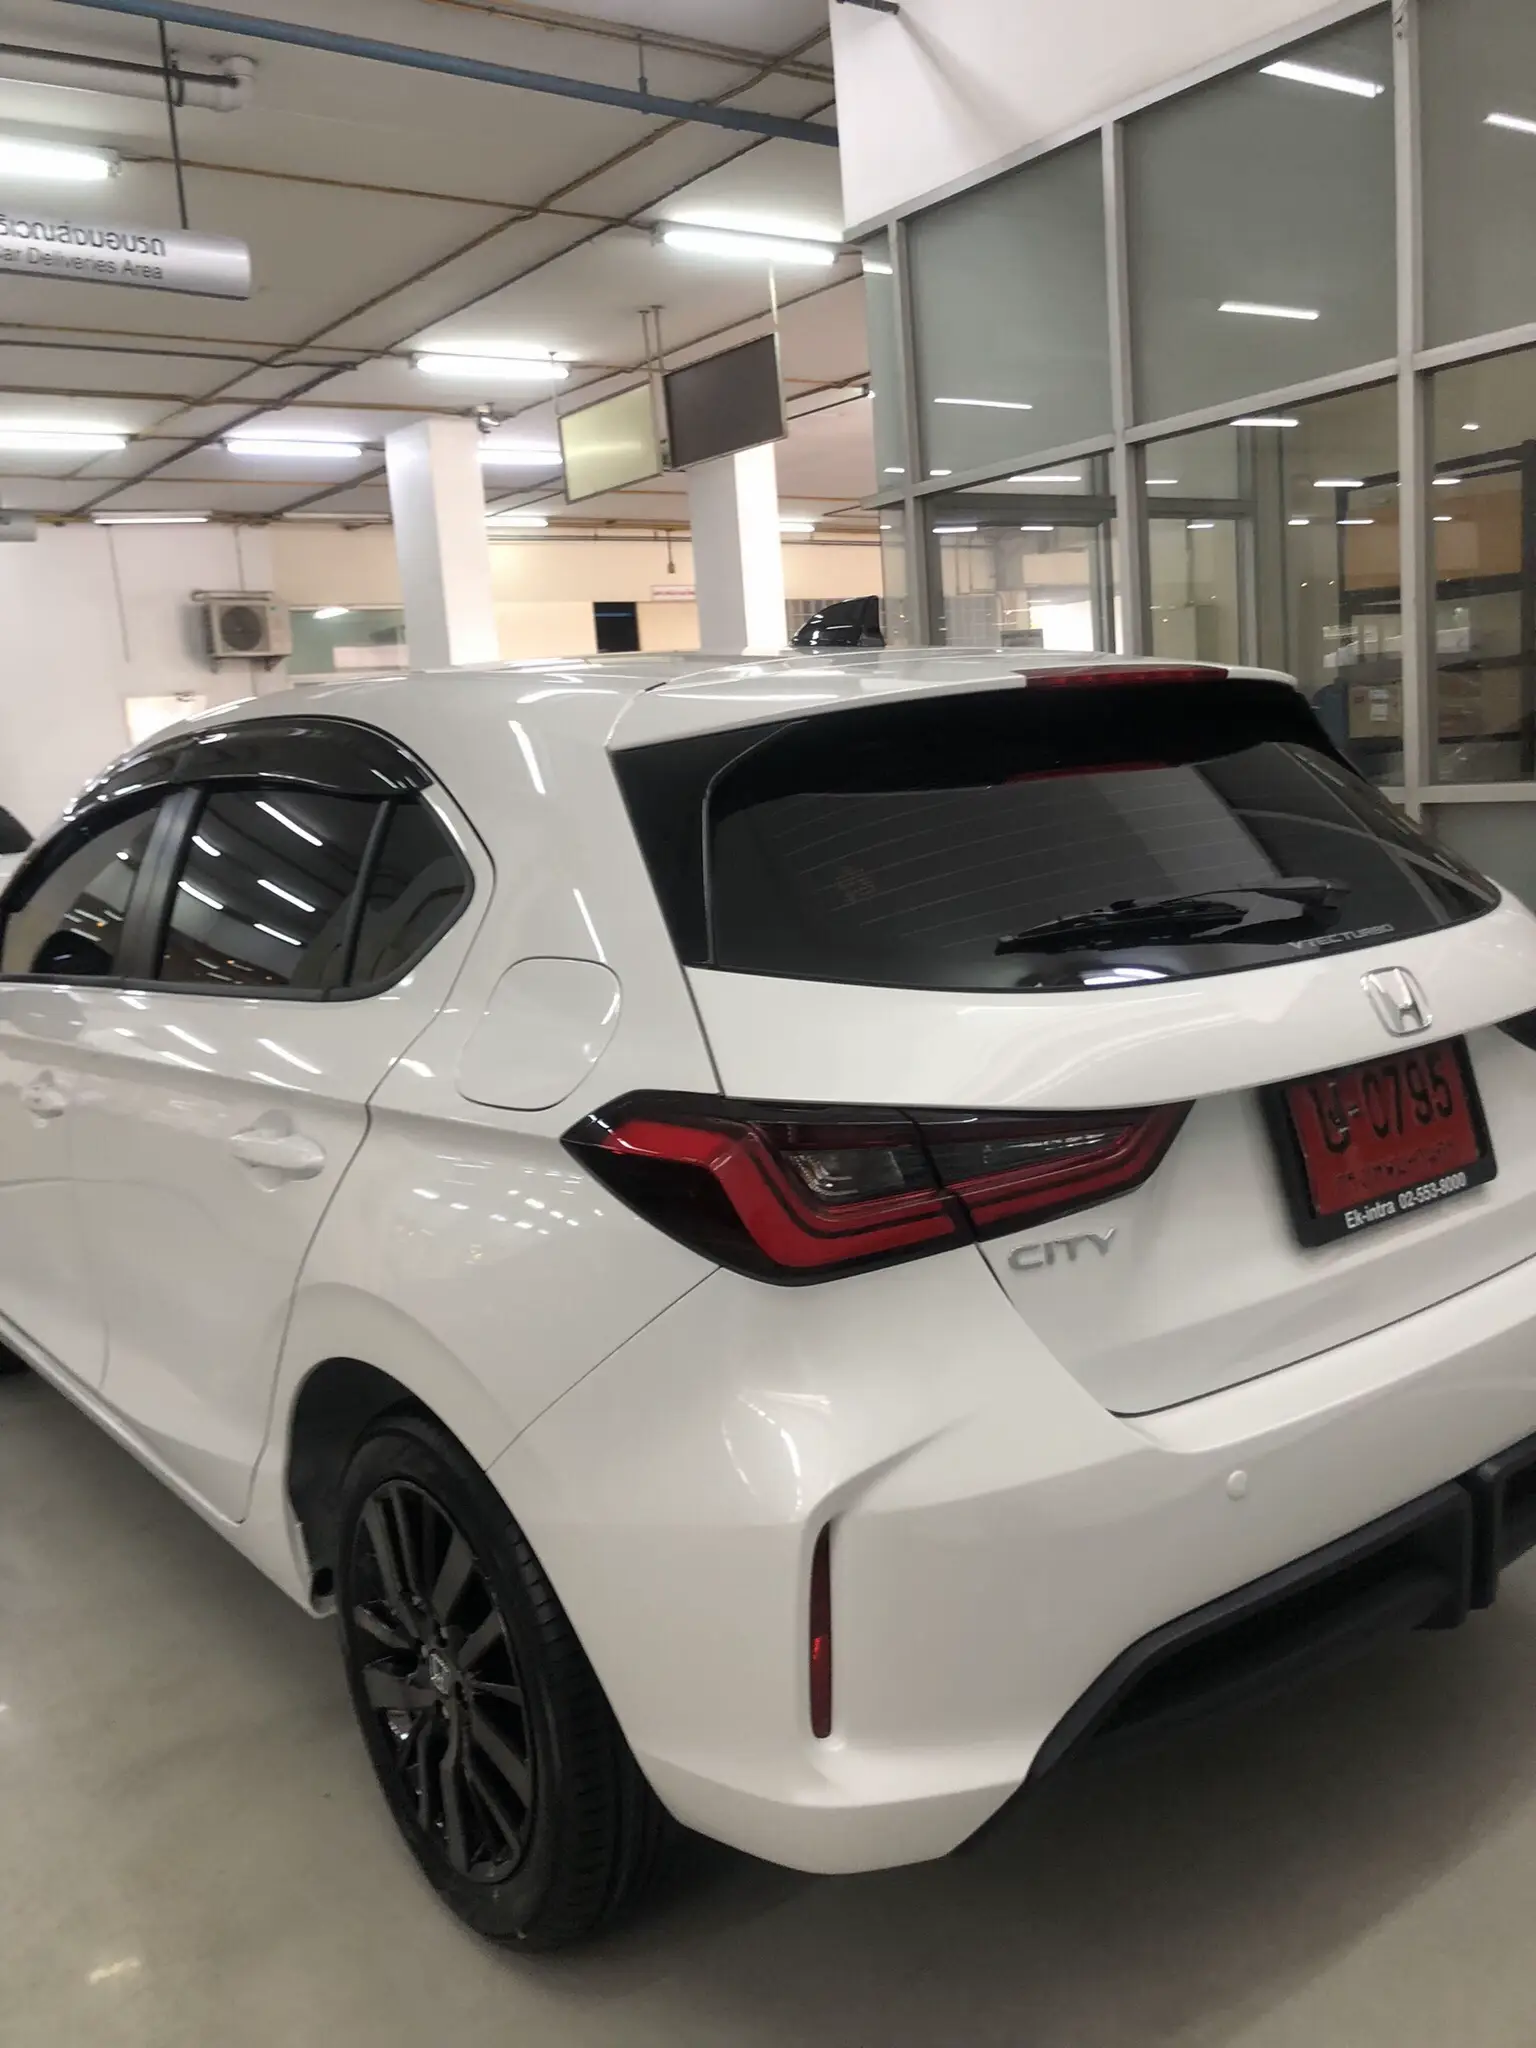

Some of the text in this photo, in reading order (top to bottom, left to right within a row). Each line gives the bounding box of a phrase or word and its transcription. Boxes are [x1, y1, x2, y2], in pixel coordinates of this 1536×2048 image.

[27, 246, 118, 275] Deliveries
[121, 258, 164, 280] Area
[1344, 1199, 1397, 1231] Ek-intra
[1007, 1226, 1117, 1270] CITY
